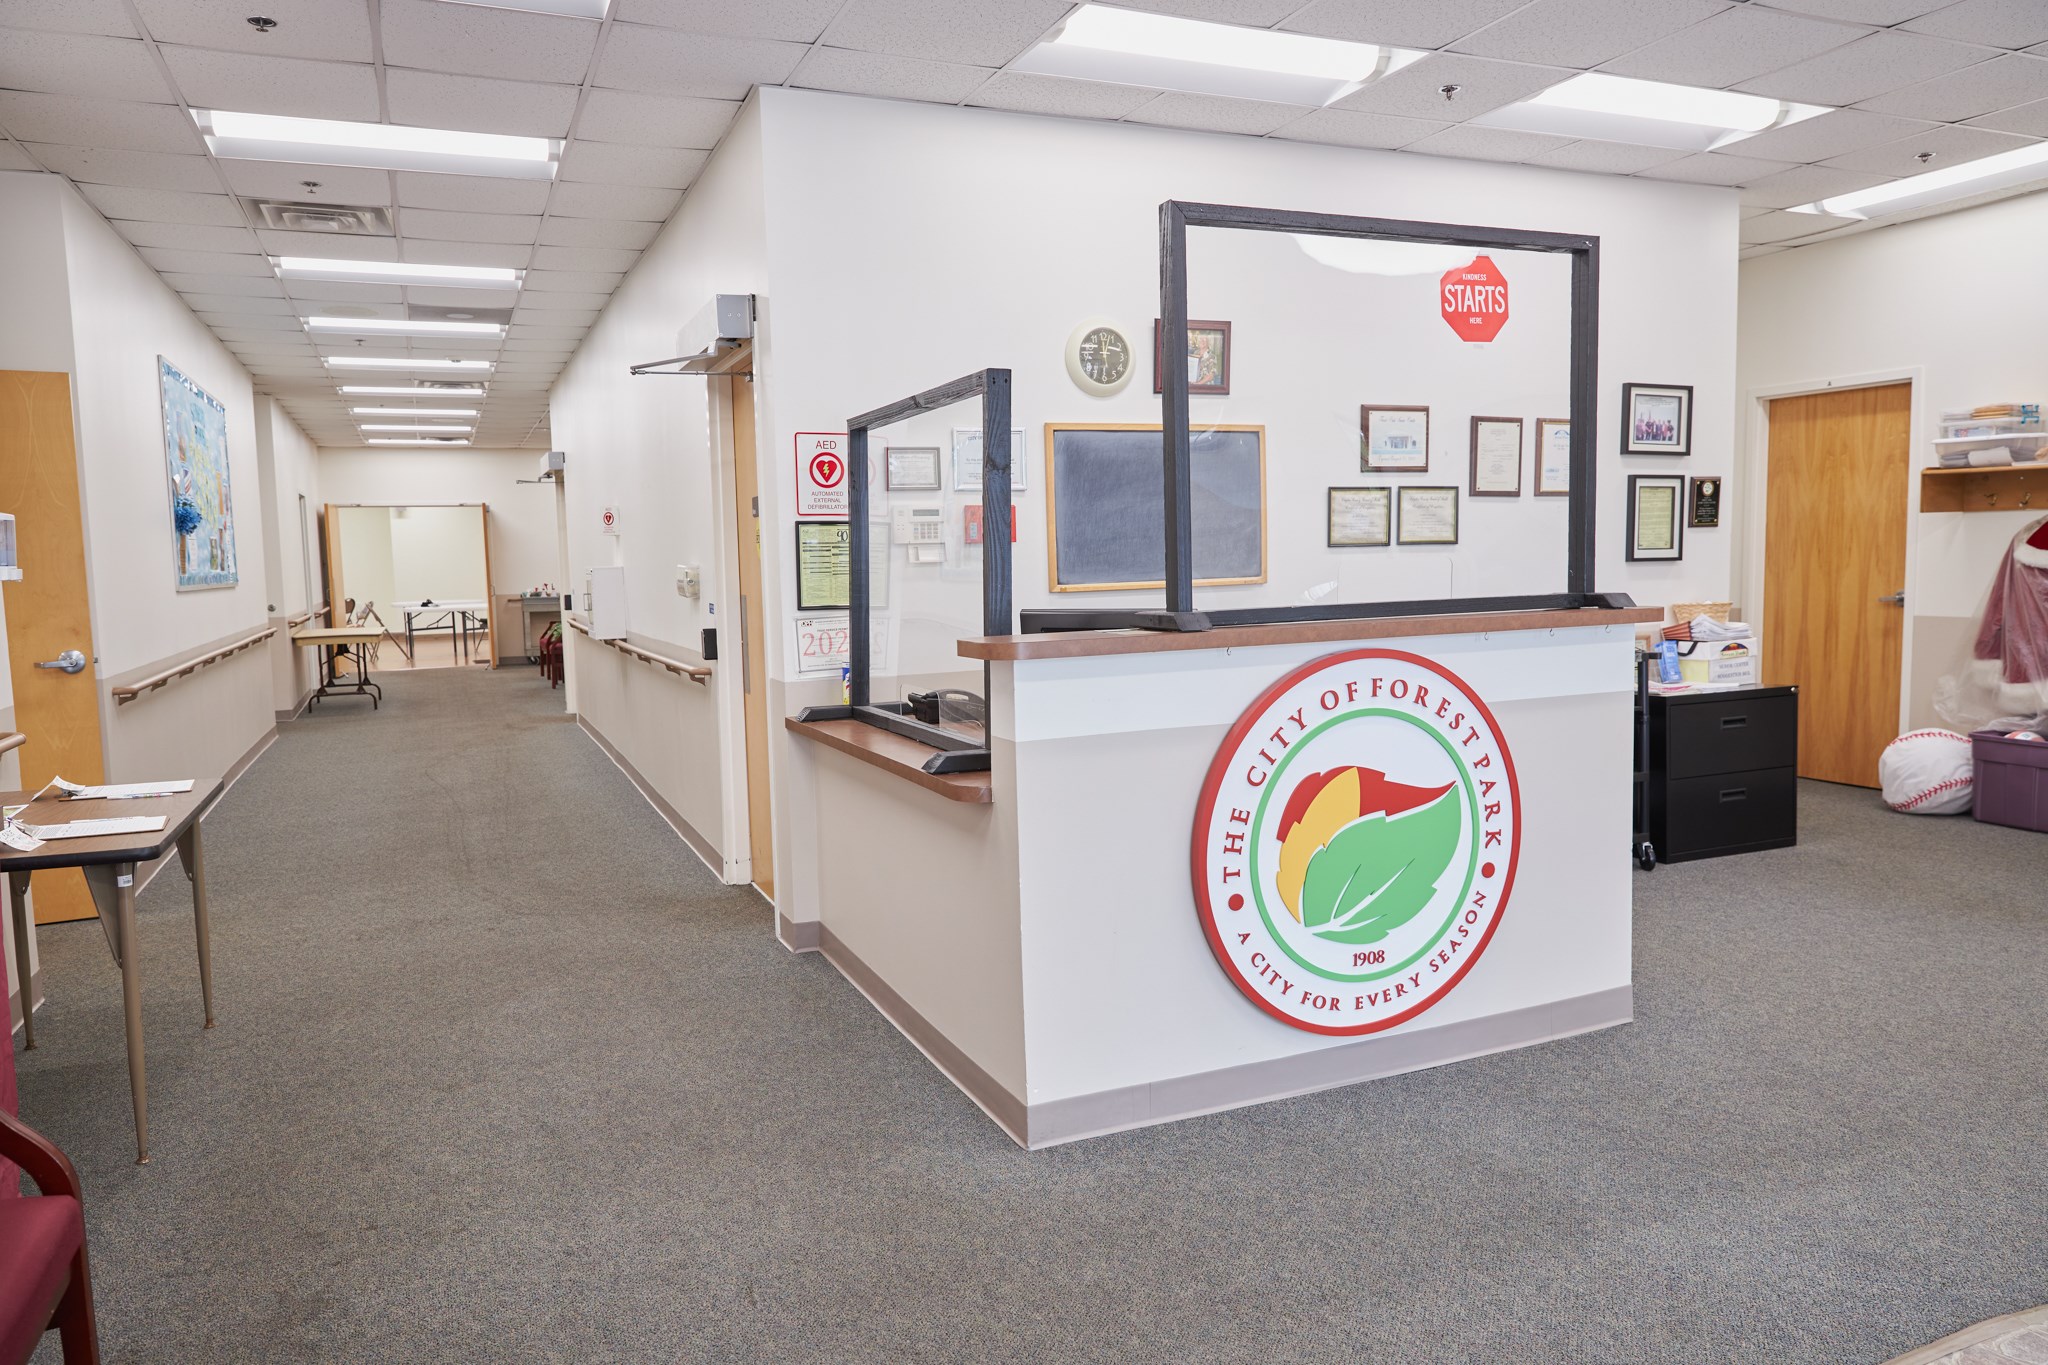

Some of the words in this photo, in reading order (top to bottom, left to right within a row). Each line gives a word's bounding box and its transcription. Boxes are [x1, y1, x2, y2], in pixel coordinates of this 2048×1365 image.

[1444, 284, 1506, 314] STARTS
[1091, 335, 1097, 343] 11
[1099, 332, 1107, 340] 12
[1120, 353, 1124, 362] 3
[1112, 371, 1116, 379] 5
[815, 440, 836, 450] AED
[802, 630, 849, 657] 202
[1223, 807, 1251, 884] THE
[1246, 707, 1308, 787] CITY
[1319, 681, 1359, 711] OF
[1370, 677, 1481, 747] FOREST
[1472, 753, 1502, 849] PARK
[1237, 932, 1251, 946] A
[1250, 952, 1295, 996] CITY
[1299, 990, 1342, 1012] FOR
[1354, 972, 1422, 1011] EVERY
[1428, 890, 1488, 973] SEASON
[1352, 950, 1385, 967] 1908
